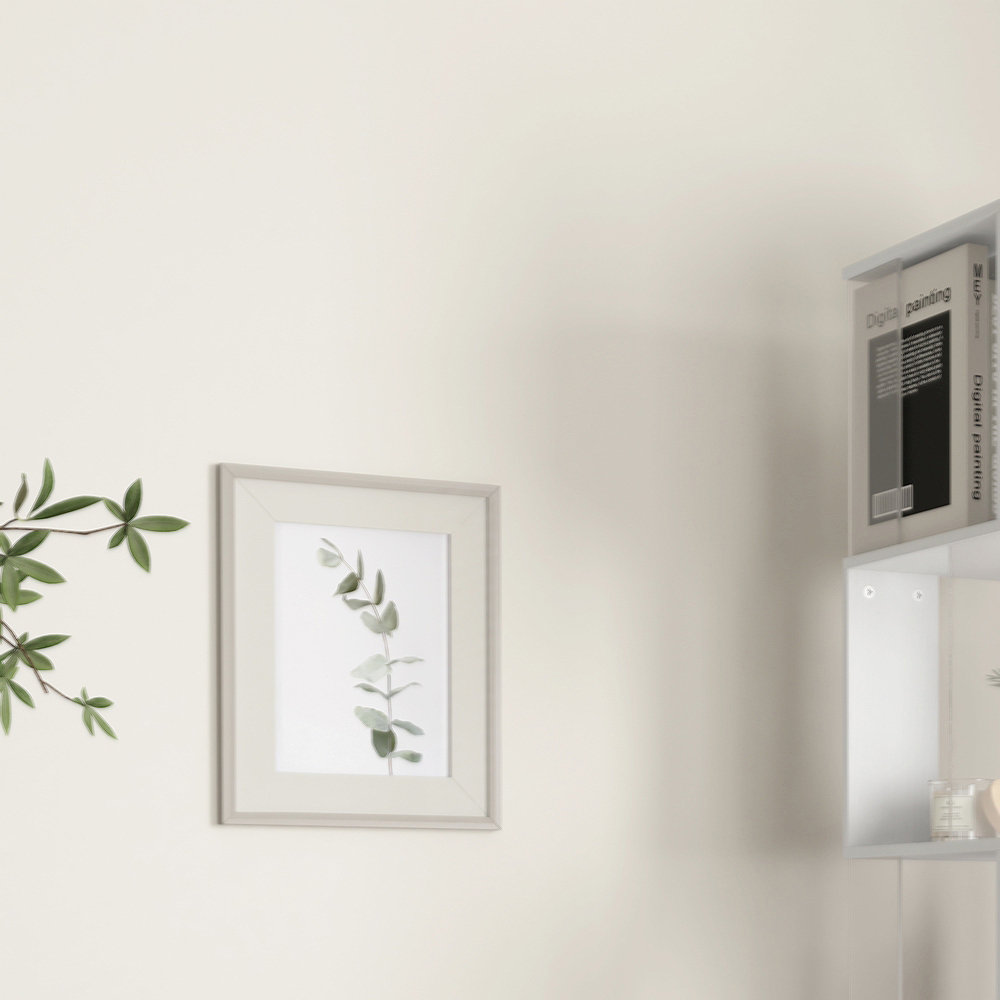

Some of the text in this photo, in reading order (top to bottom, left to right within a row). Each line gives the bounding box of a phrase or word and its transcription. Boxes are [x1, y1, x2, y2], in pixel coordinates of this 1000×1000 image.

[866, 286, 952, 329] Digita painting
[971, 374, 983, 501] Digital painting
